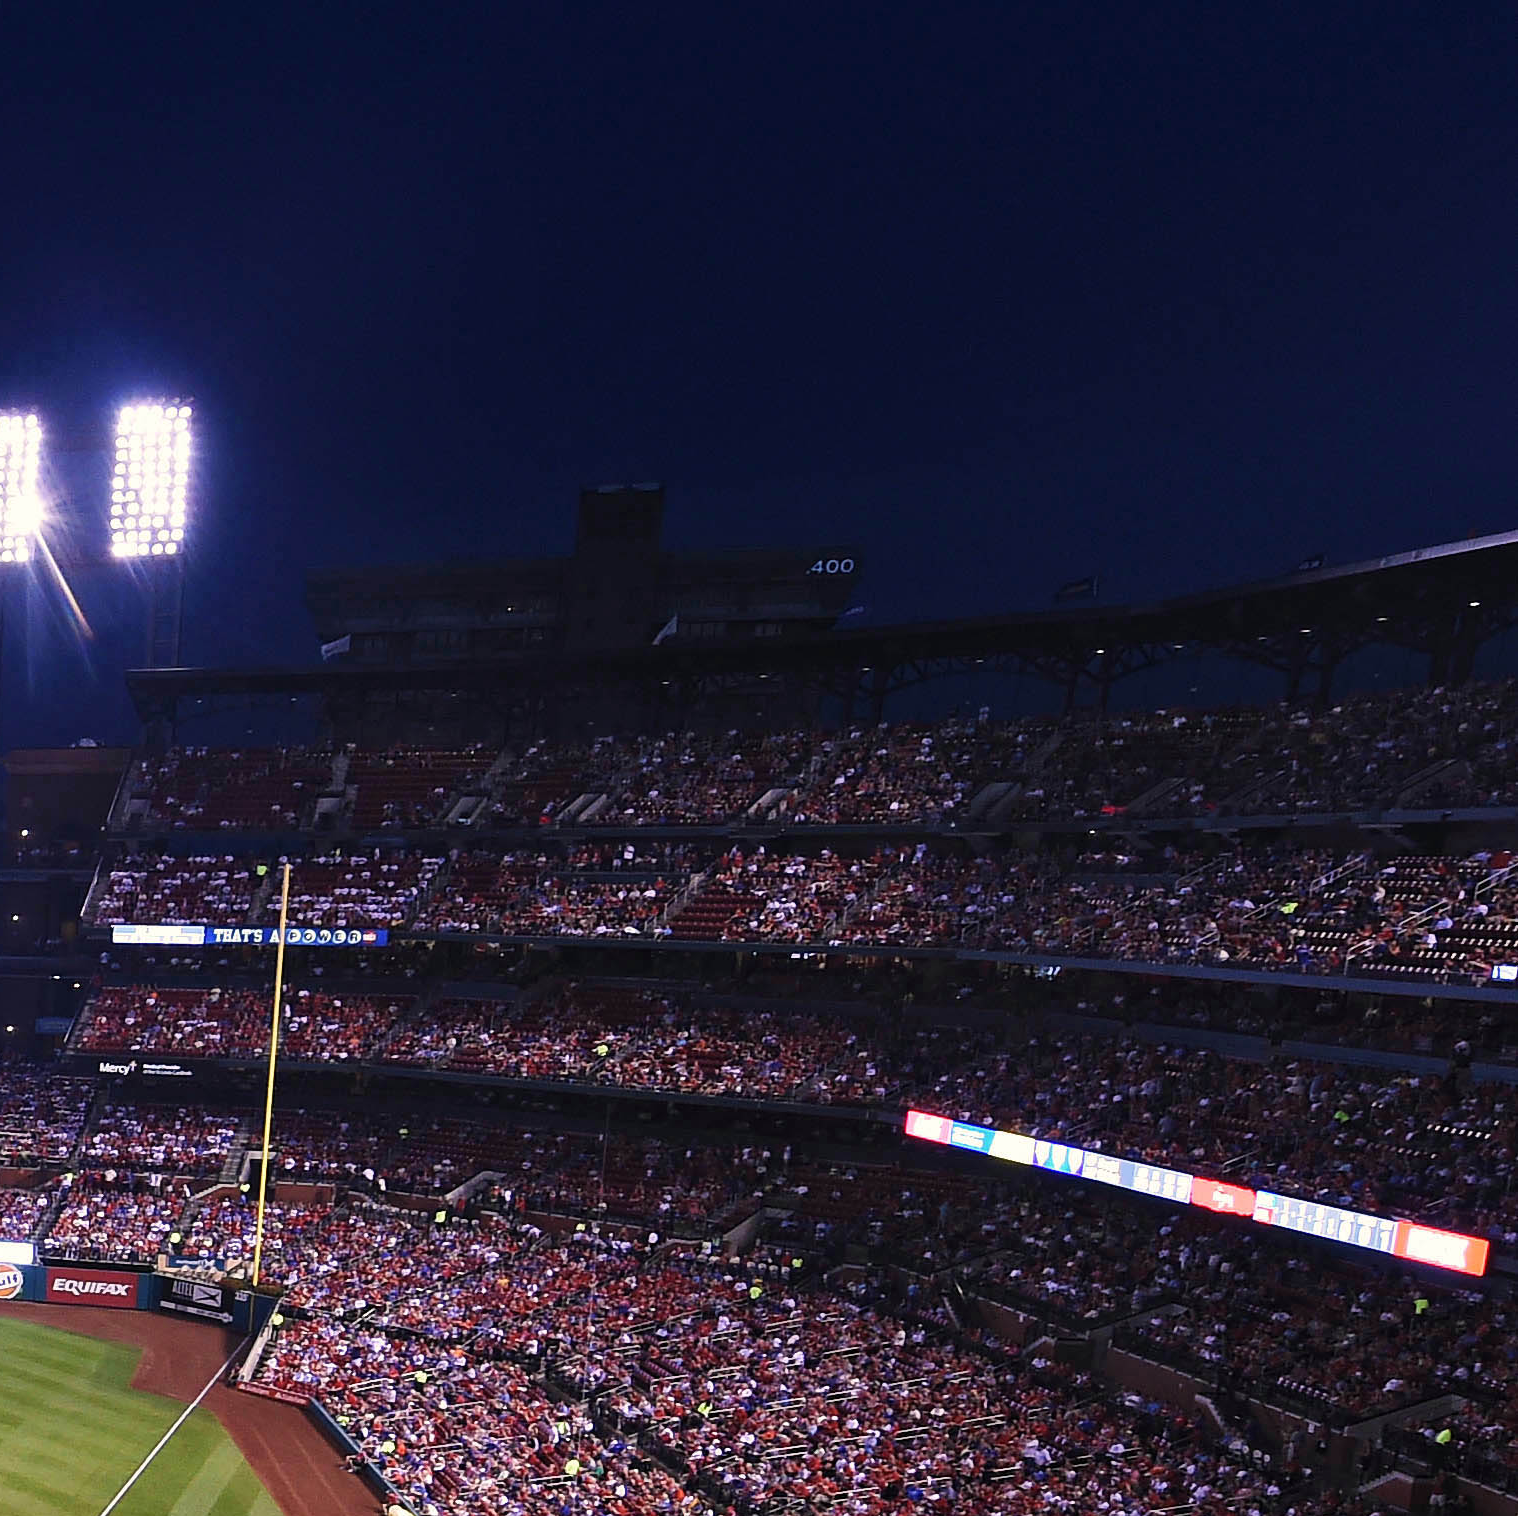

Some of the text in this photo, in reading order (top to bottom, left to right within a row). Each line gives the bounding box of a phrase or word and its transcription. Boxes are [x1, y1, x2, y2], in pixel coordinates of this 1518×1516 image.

[213, 928, 263, 943] THAT'S
[269, 930, 280, 943] A
[289, 930, 361, 944] POWER
[99, 1062, 130, 1076] Mercy
[53, 1278, 132, 1297] EQUIFAX
